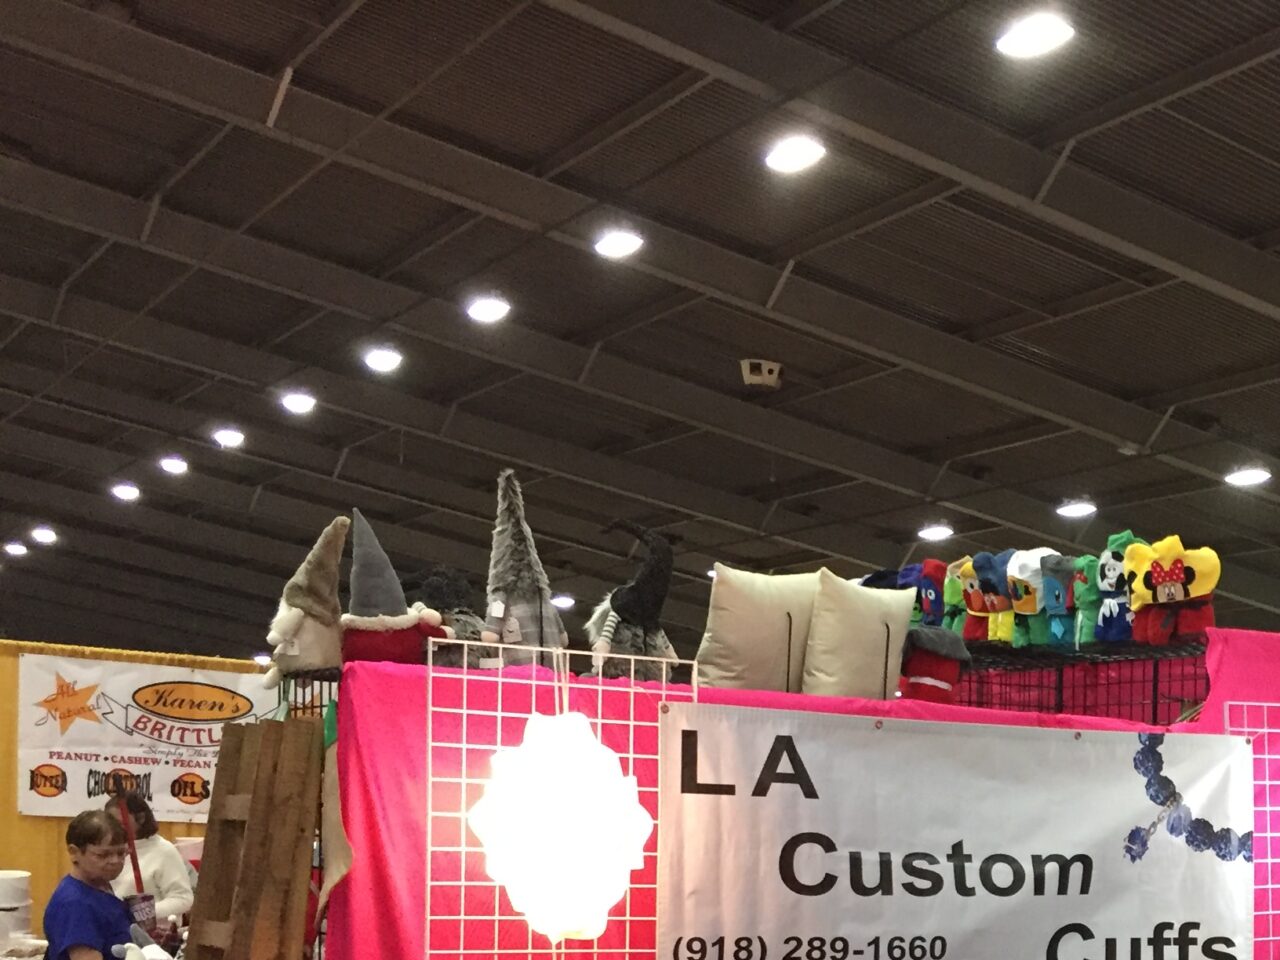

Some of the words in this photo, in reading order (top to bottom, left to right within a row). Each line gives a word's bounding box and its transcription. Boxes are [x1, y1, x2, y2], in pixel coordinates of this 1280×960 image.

[144, 688, 240, 713] Karen's
[133, 714, 221, 744] BRITTL
[49, 751, 101, 762] PEANUT
[111, 755, 162, 766] CASHEW
[173, 759, 211, 769] PECAN
[171, 778, 211, 800] OILS
[778, 832, 1094, 898] Custom
